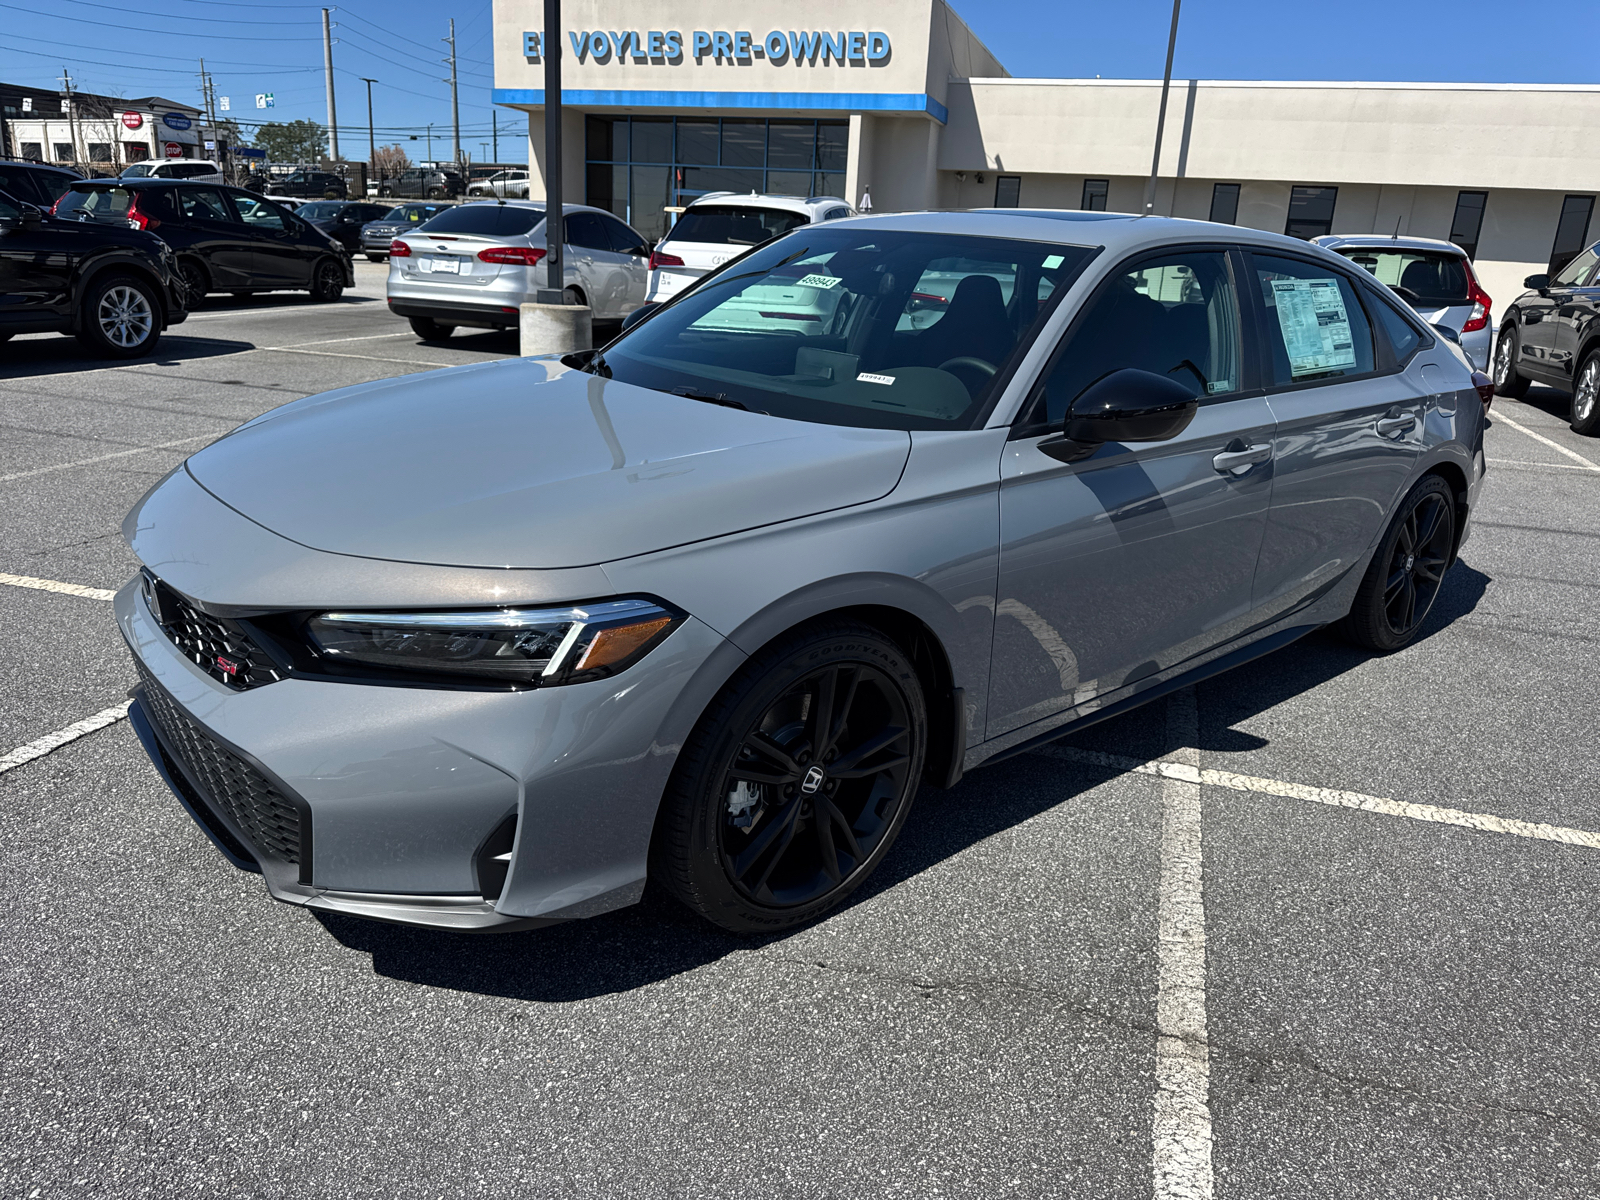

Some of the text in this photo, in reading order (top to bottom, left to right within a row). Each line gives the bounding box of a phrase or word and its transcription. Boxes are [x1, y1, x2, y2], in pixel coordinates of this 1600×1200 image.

[523, 30, 891, 61] E VOYLES PRE-OWNED
[801, 276, 837, 287] 499943
[217, 656, 237, 675] Si
[738, 912, 782, 925] SPORT
